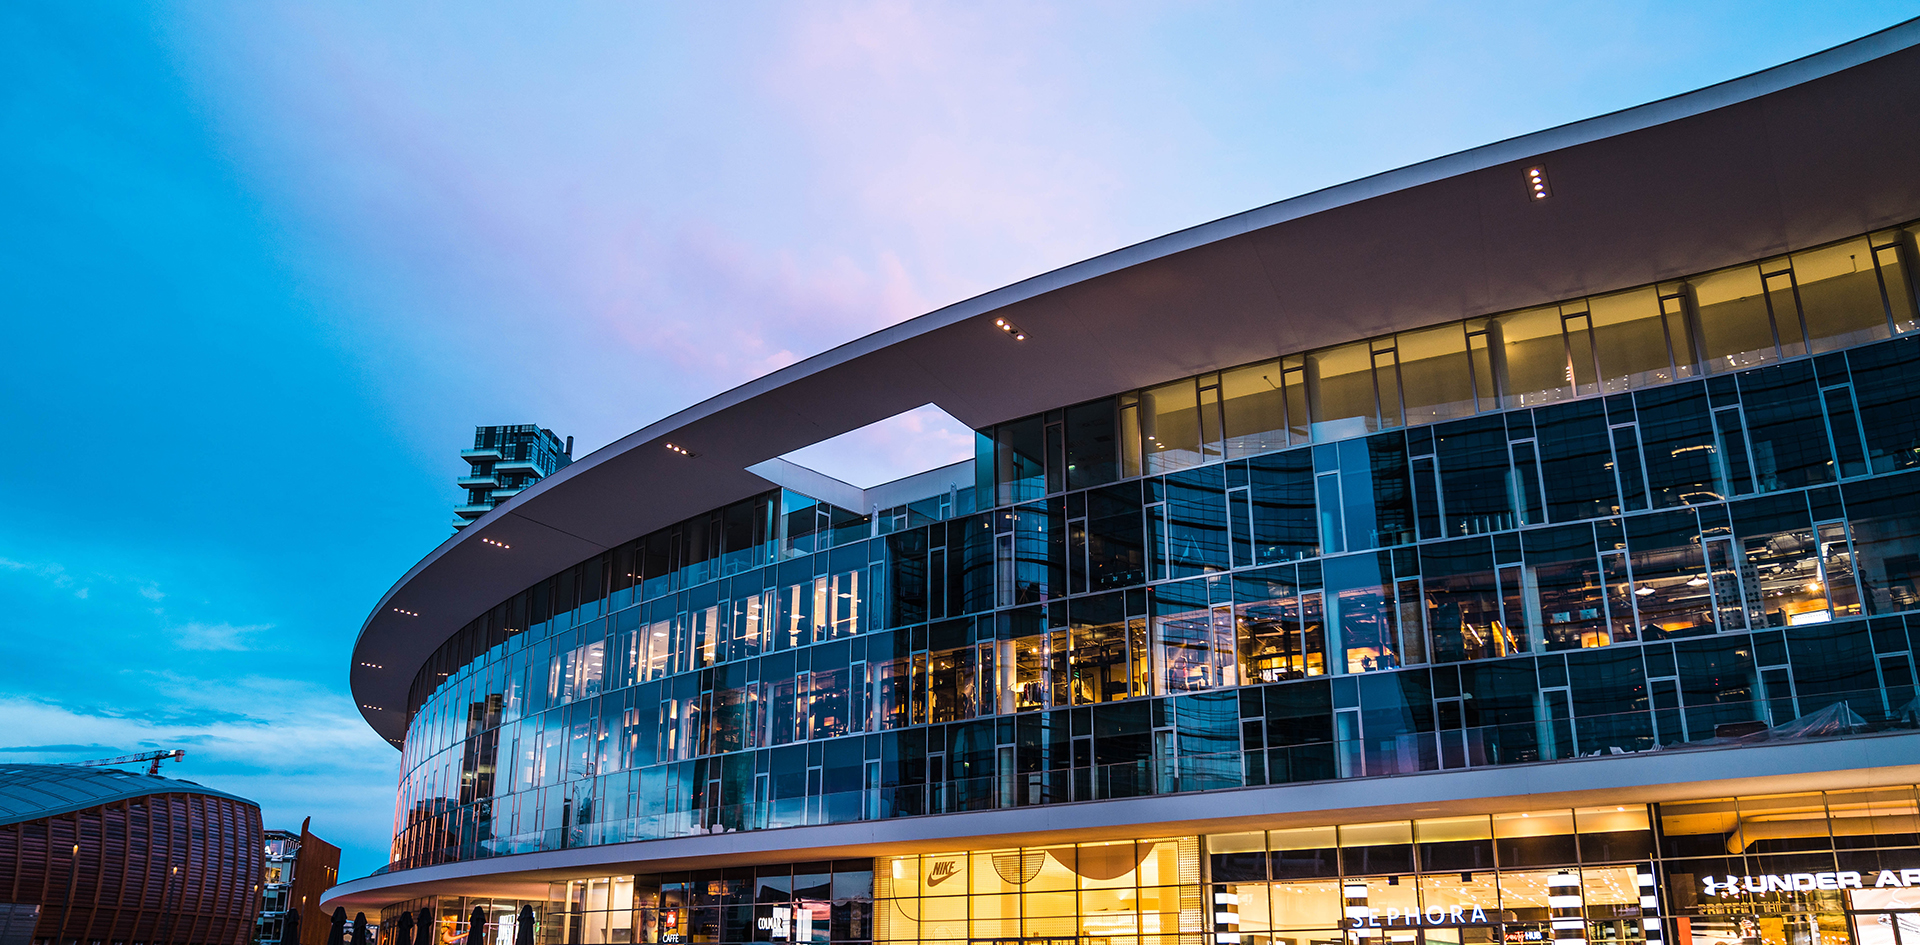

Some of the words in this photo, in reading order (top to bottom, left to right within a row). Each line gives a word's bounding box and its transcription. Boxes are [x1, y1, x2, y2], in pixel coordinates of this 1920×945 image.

[932, 861, 955, 875] NIKE
[1744, 871, 1862, 893] UNDER
[1352, 904, 1487, 928] SEPHORA
[1524, 931, 1542, 940] HUB
